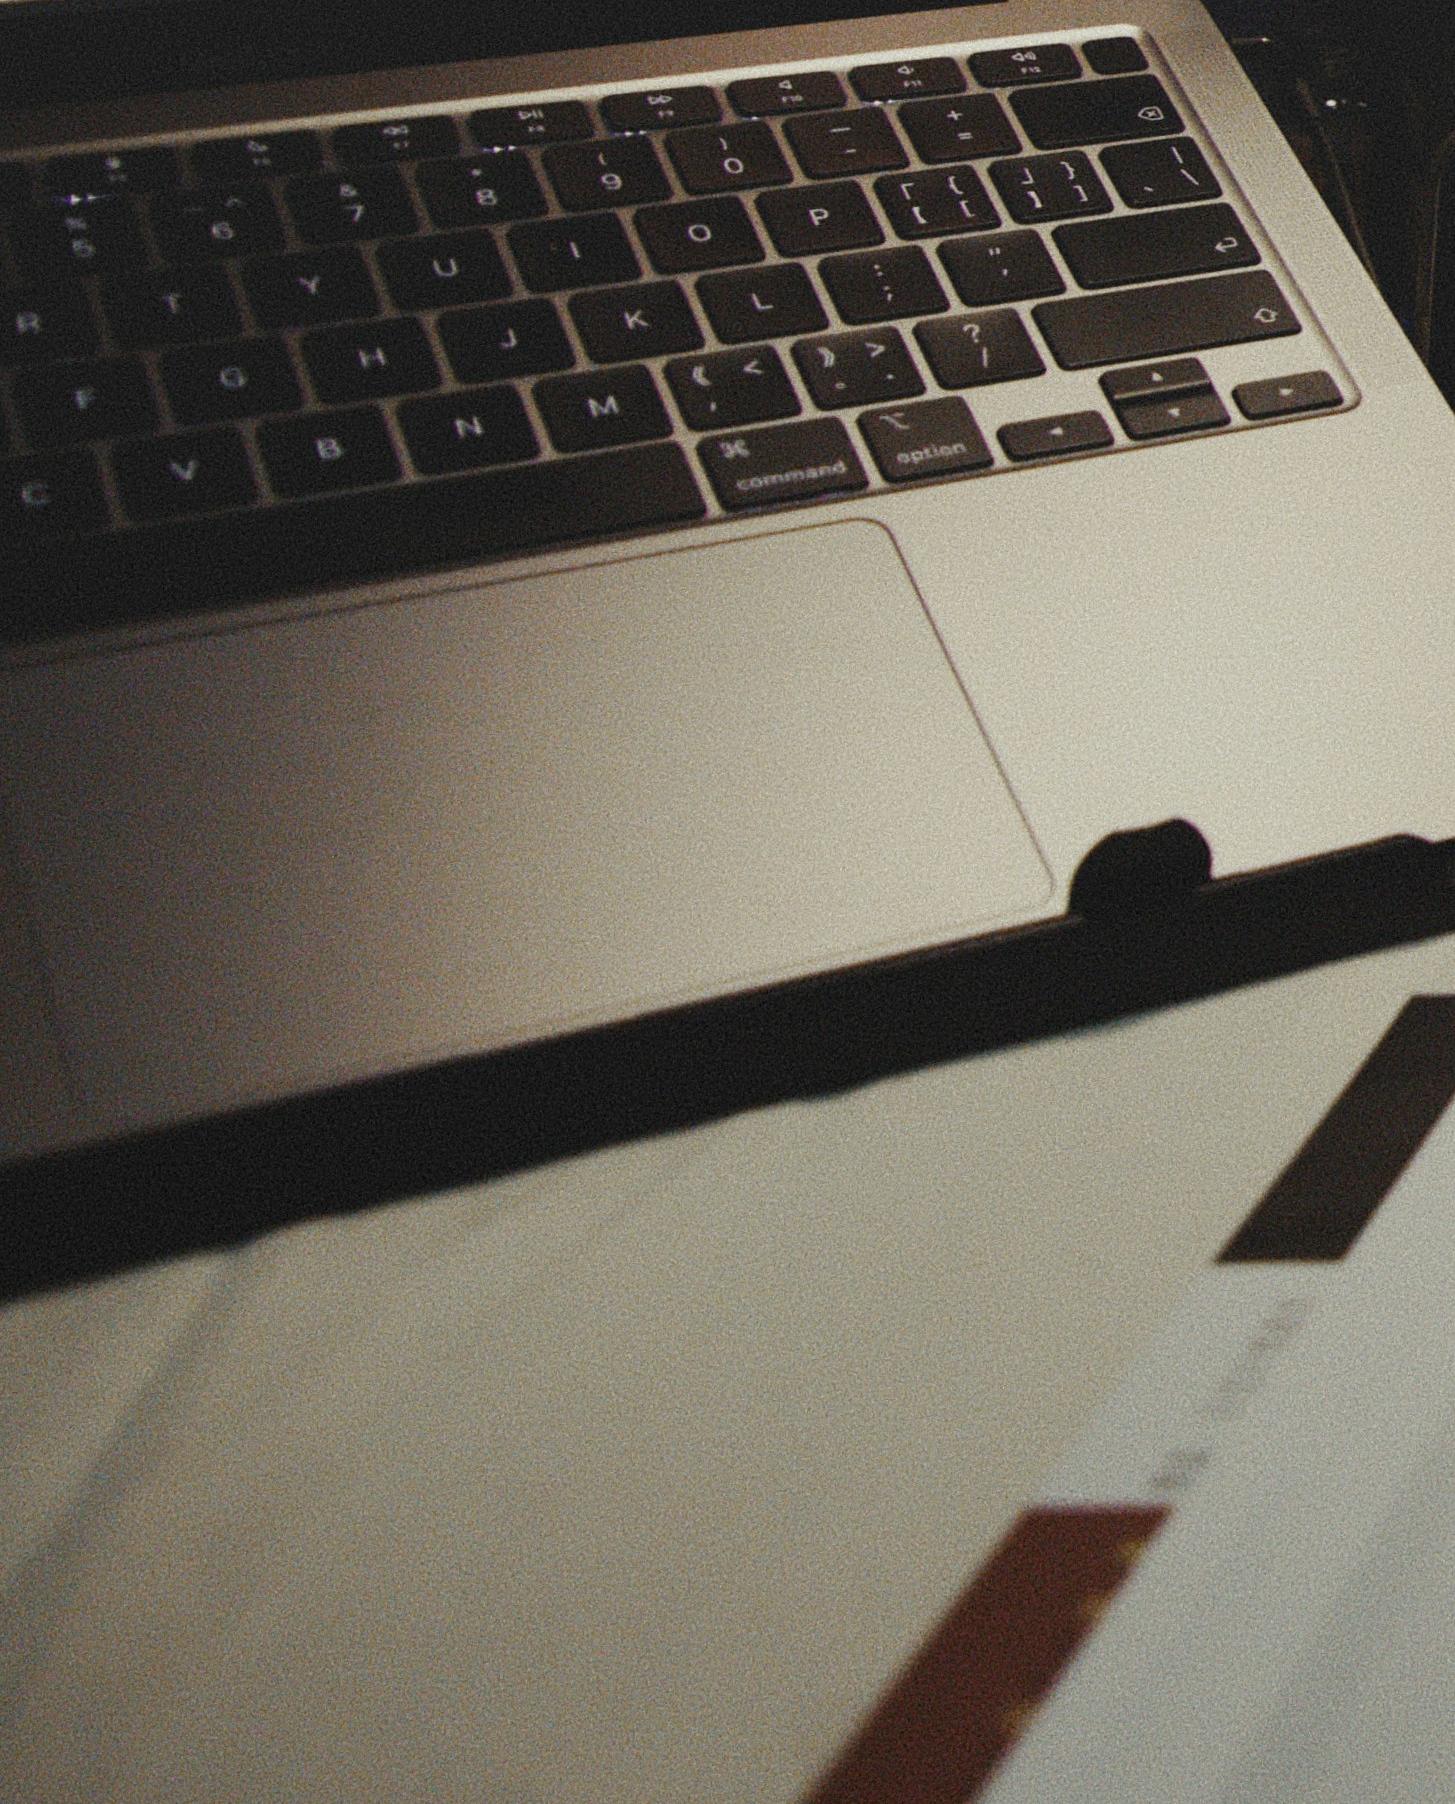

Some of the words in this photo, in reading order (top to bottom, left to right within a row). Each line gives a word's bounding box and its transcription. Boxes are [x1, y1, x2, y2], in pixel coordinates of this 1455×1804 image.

[602, 173, 622, 191] 9
[810, 205, 831, 227] P
[687, 223, 712, 242] O
[432, 258, 458, 278] U
[299, 275, 321, 296] Y
[751, 291, 774, 314] L
[623, 308, 648, 332] K
[500, 328, 518, 351] J
[358, 345, 388, 370] H
[587, 395, 619, 418] M
[455, 414, 484, 439] N
[314, 436, 344, 461] B
[896, 440, 968, 466] option
[169, 458, 199, 483] V
[735, 459, 848, 492] command
